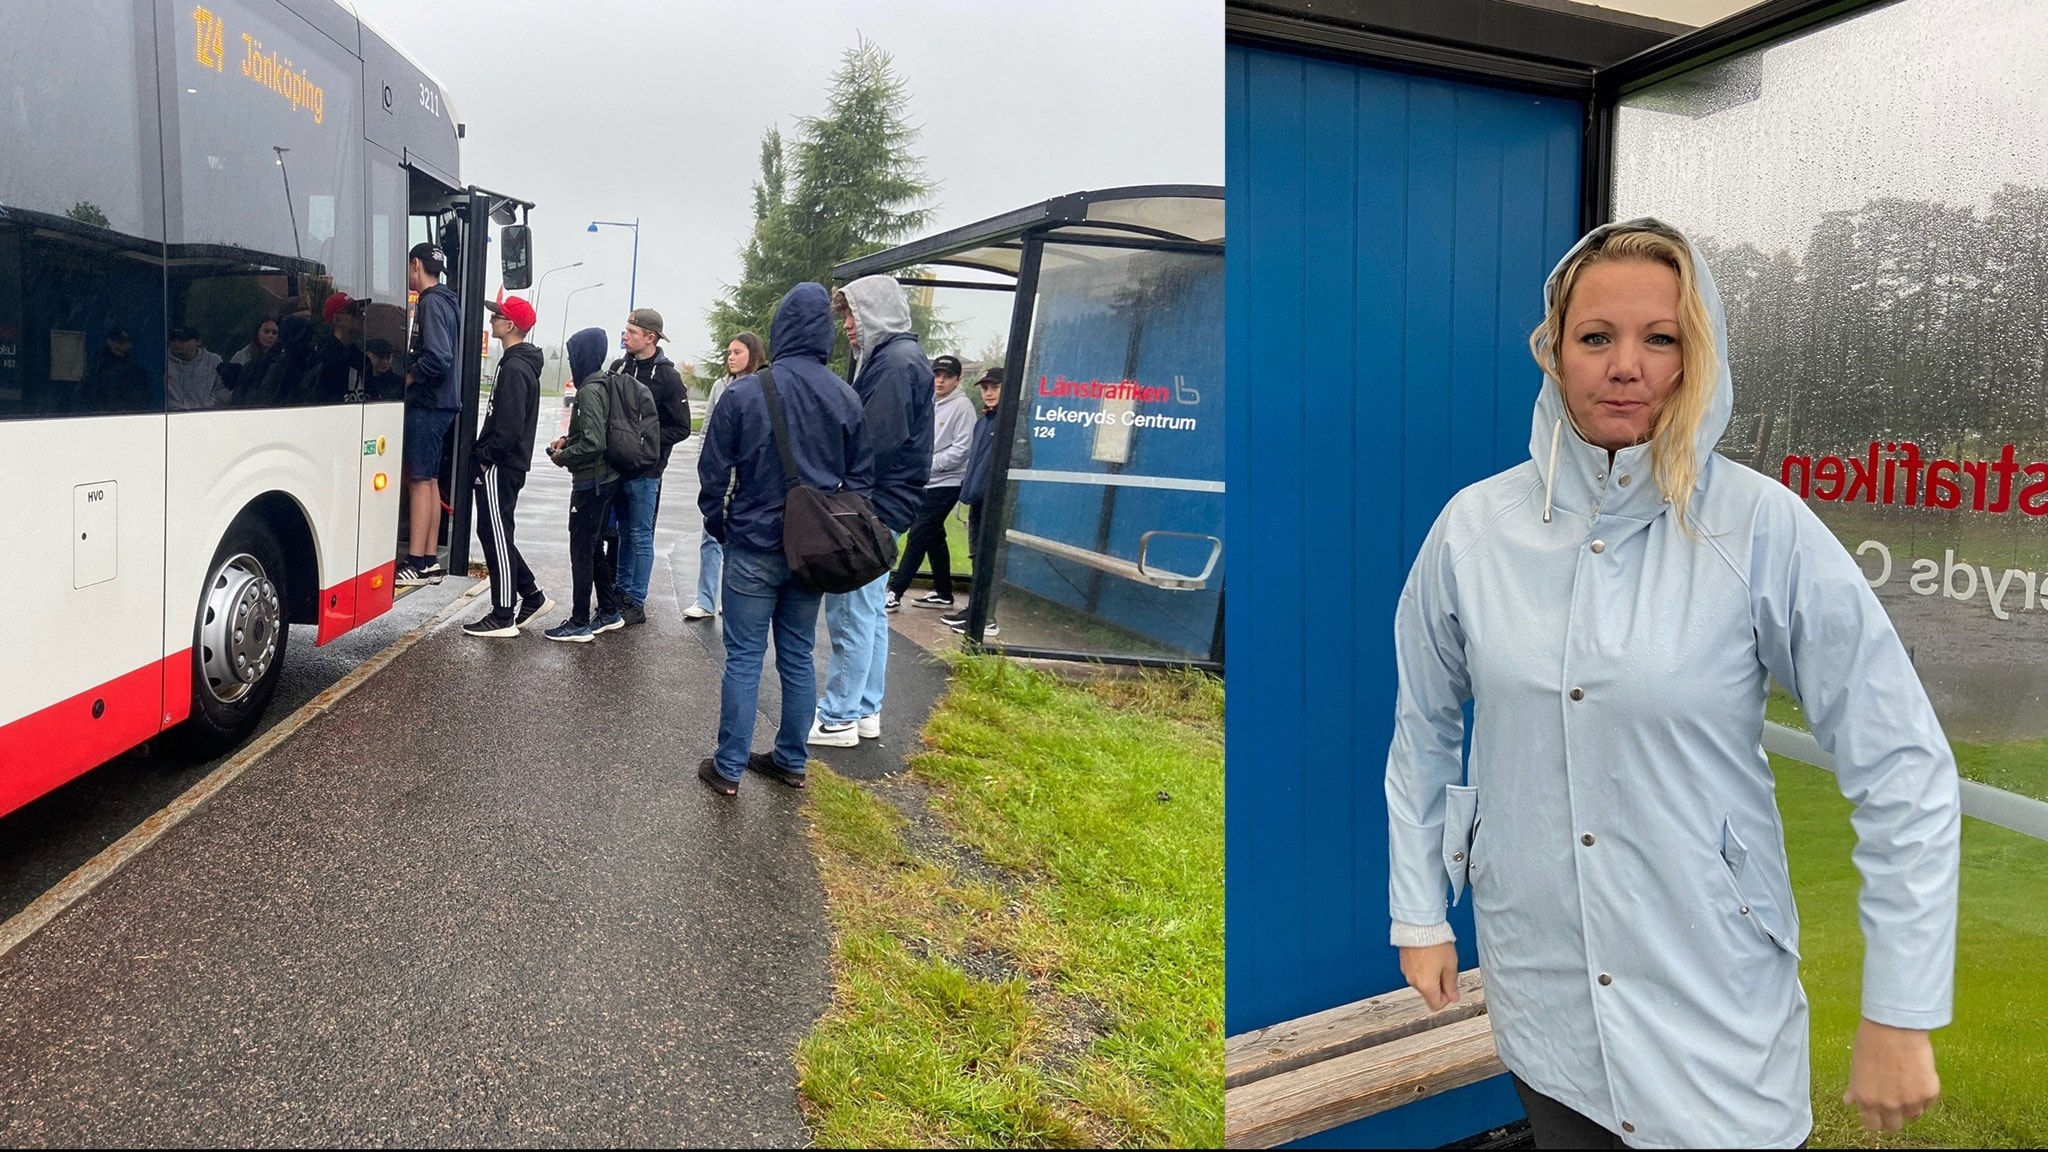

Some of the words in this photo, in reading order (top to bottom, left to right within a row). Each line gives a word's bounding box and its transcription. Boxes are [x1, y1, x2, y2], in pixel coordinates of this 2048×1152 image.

[193, 5, 224, 73] 124
[242, 32, 323, 124] Jönköping
[419, 82, 440, 118] 3211
[1039, 374, 1170, 404] Länstrafiken
[1035, 404, 1117, 428] Lekeryds
[1121, 410, 1197, 431] Centrum
[1033, 426, 1056, 438] 124
[87, 489, 104, 503] HVO
